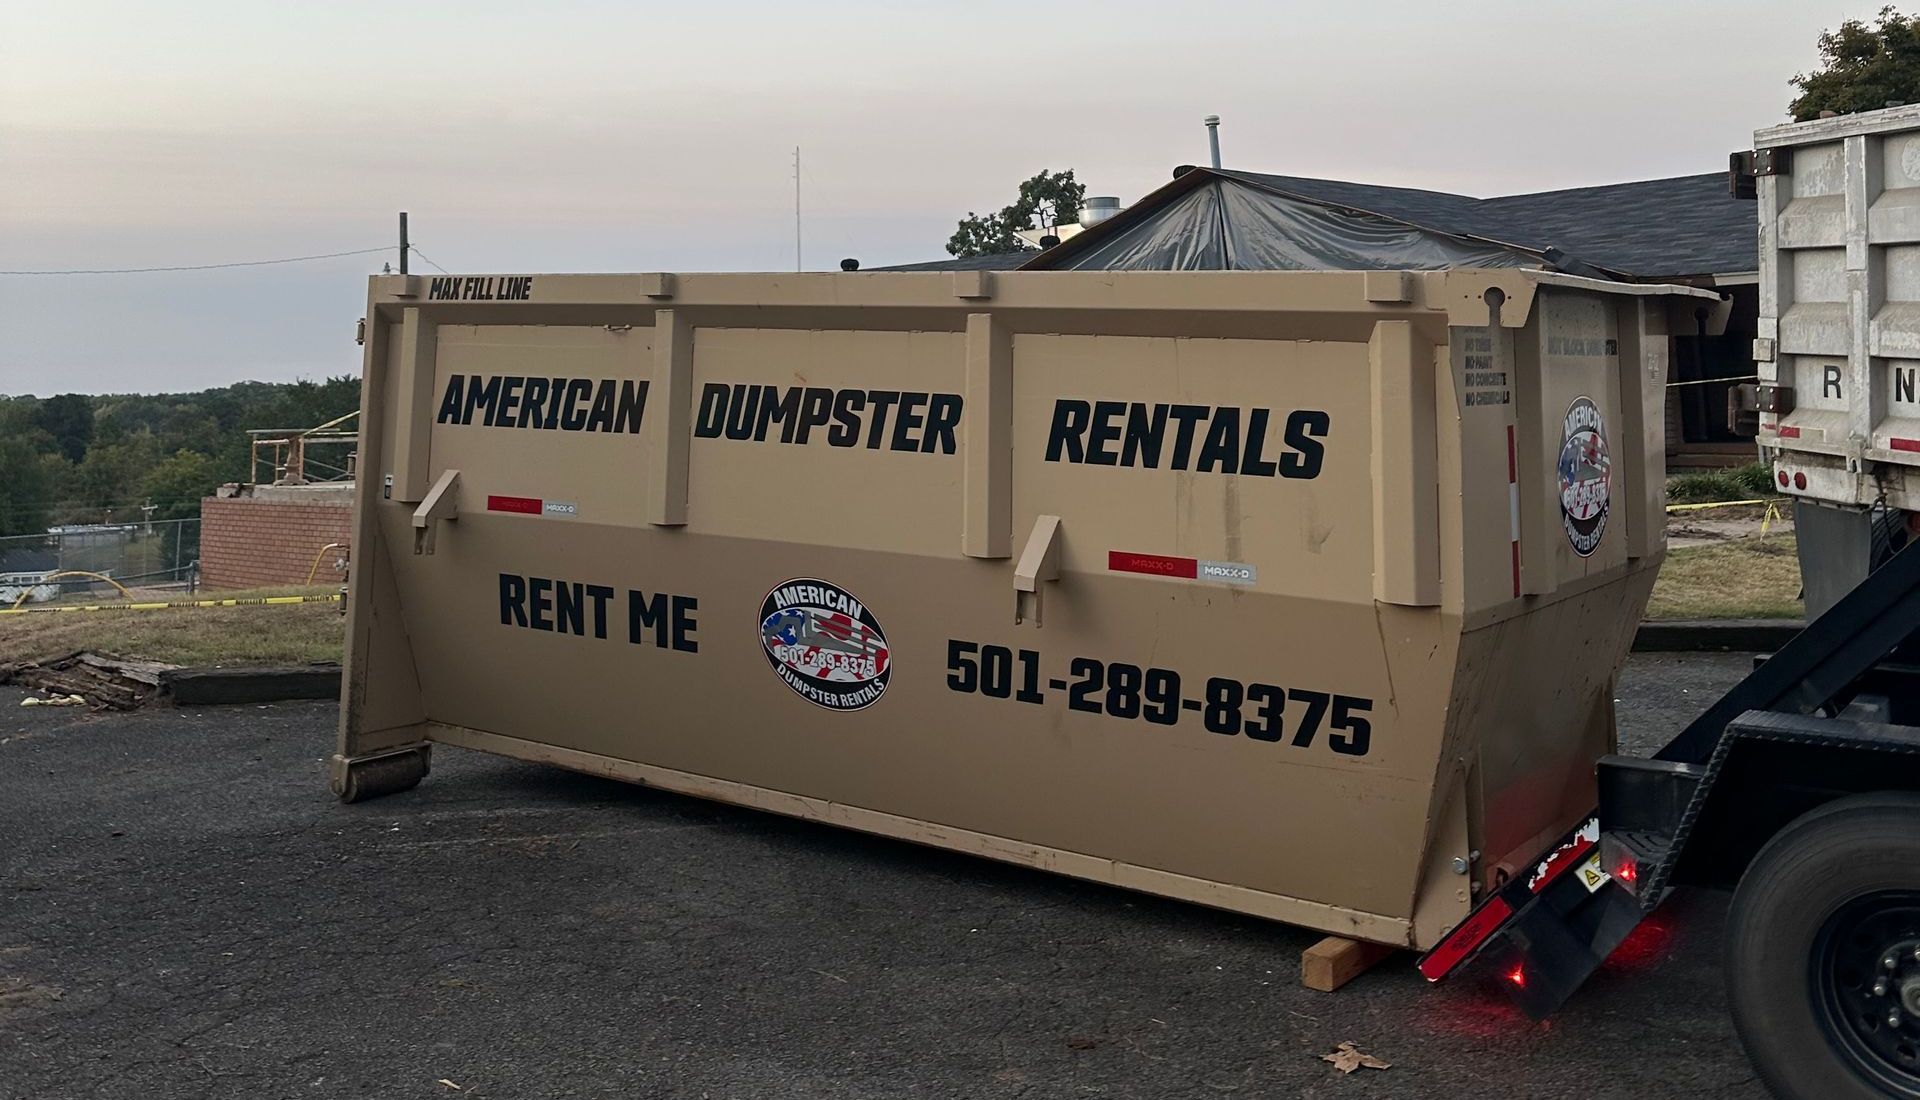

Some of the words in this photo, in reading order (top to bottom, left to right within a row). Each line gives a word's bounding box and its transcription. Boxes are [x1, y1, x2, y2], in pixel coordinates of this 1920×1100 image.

[428, 277, 463, 300] MAX
[462, 277, 493, 300] FILL
[496, 277, 532, 300] LINE
[1465, 373, 1475, 387] NO
[1824, 365, 1841, 399] R
[1896, 367, 1920, 404] N
[1466, 392, 1475, 406] NO
[437, 374, 650, 434] AMERICAN
[694, 382, 965, 455] DUMPSTER
[1044, 398, 1330, 480] RENTALS
[546, 503, 574, 513] MAXX-D
[1131, 558, 1174, 571] MAXX-D
[1204, 566, 1249, 578] MAXX-D
[499, 573, 614, 639] RENT
[628, 589, 698, 654] ME
[773, 585, 863, 620] AMERICAN
[780, 646, 876, 677] 501-289-8375
[777, 663, 839, 706] DUMPSTER
[840, 678, 884, 707] RENTALS
[946, 638, 1374, 757] 501-289-8375
